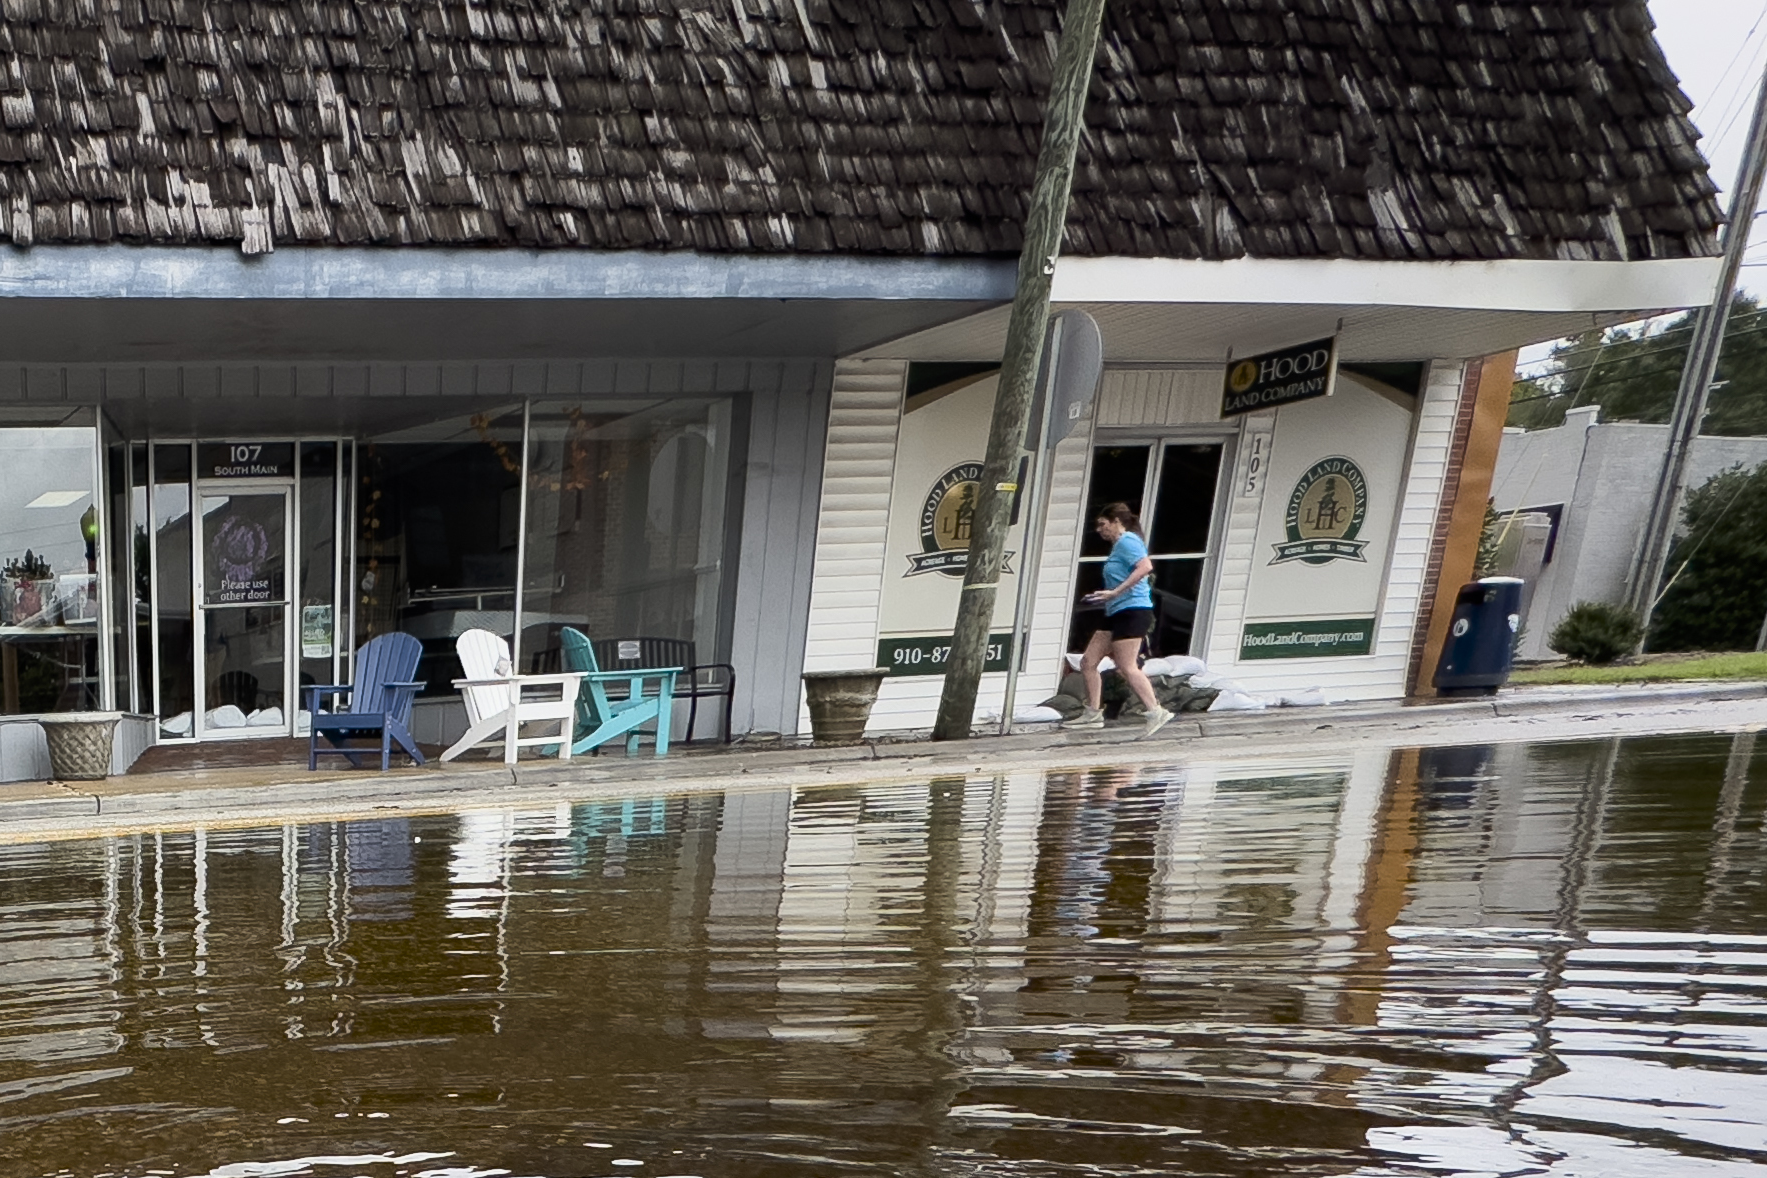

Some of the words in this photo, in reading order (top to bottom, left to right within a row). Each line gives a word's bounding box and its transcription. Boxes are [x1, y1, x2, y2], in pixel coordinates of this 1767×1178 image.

[1258, 349, 1329, 384] HOOD
[1224, 392, 1260, 411] LAND
[1261, 377, 1326, 402] COMPANY
[230, 445, 263, 463] 107
[1246, 437, 1262, 493] 105
[214, 465, 249, 476] SOUTH
[250, 464, 278, 474] MAIN
[921, 489, 943, 537] HOOD
[941, 467, 979, 490] LAND
[1286, 481, 1309, 528] HOOD
[1308, 461, 1341, 484] LAND
[1342, 462, 1365, 524] COMPANY
[220, 591, 246, 601] other
[247, 589, 270, 600] door
[221, 579, 250, 590] Please
[252, 580, 269, 589] use
[1243, 631, 1364, 647] HoodLandCompany.com
